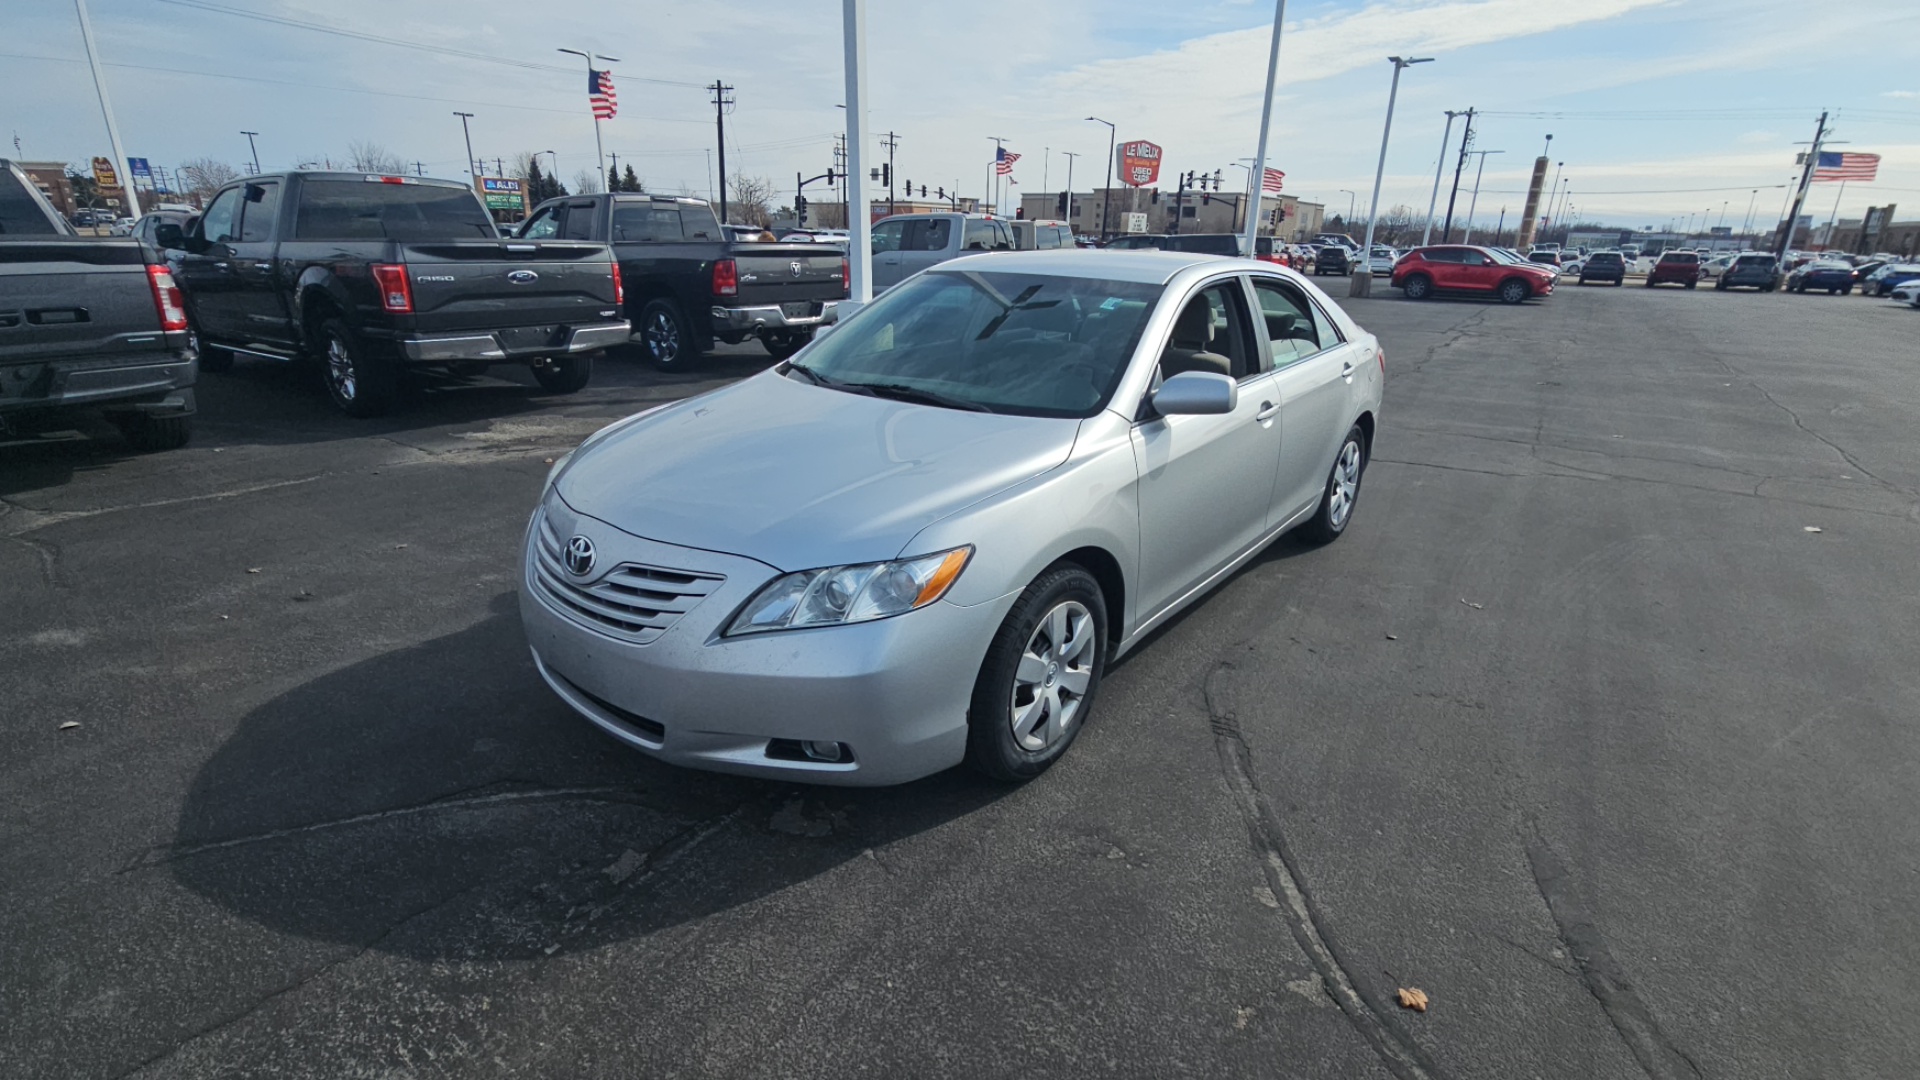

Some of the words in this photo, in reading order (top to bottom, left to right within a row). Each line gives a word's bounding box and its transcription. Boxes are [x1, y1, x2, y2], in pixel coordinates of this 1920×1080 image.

[1126, 144, 1136, 156] LE
[1131, 166, 1152, 176] USED
[1133, 173, 1150, 183] CARS
[496, 180, 519, 190] ALDI
